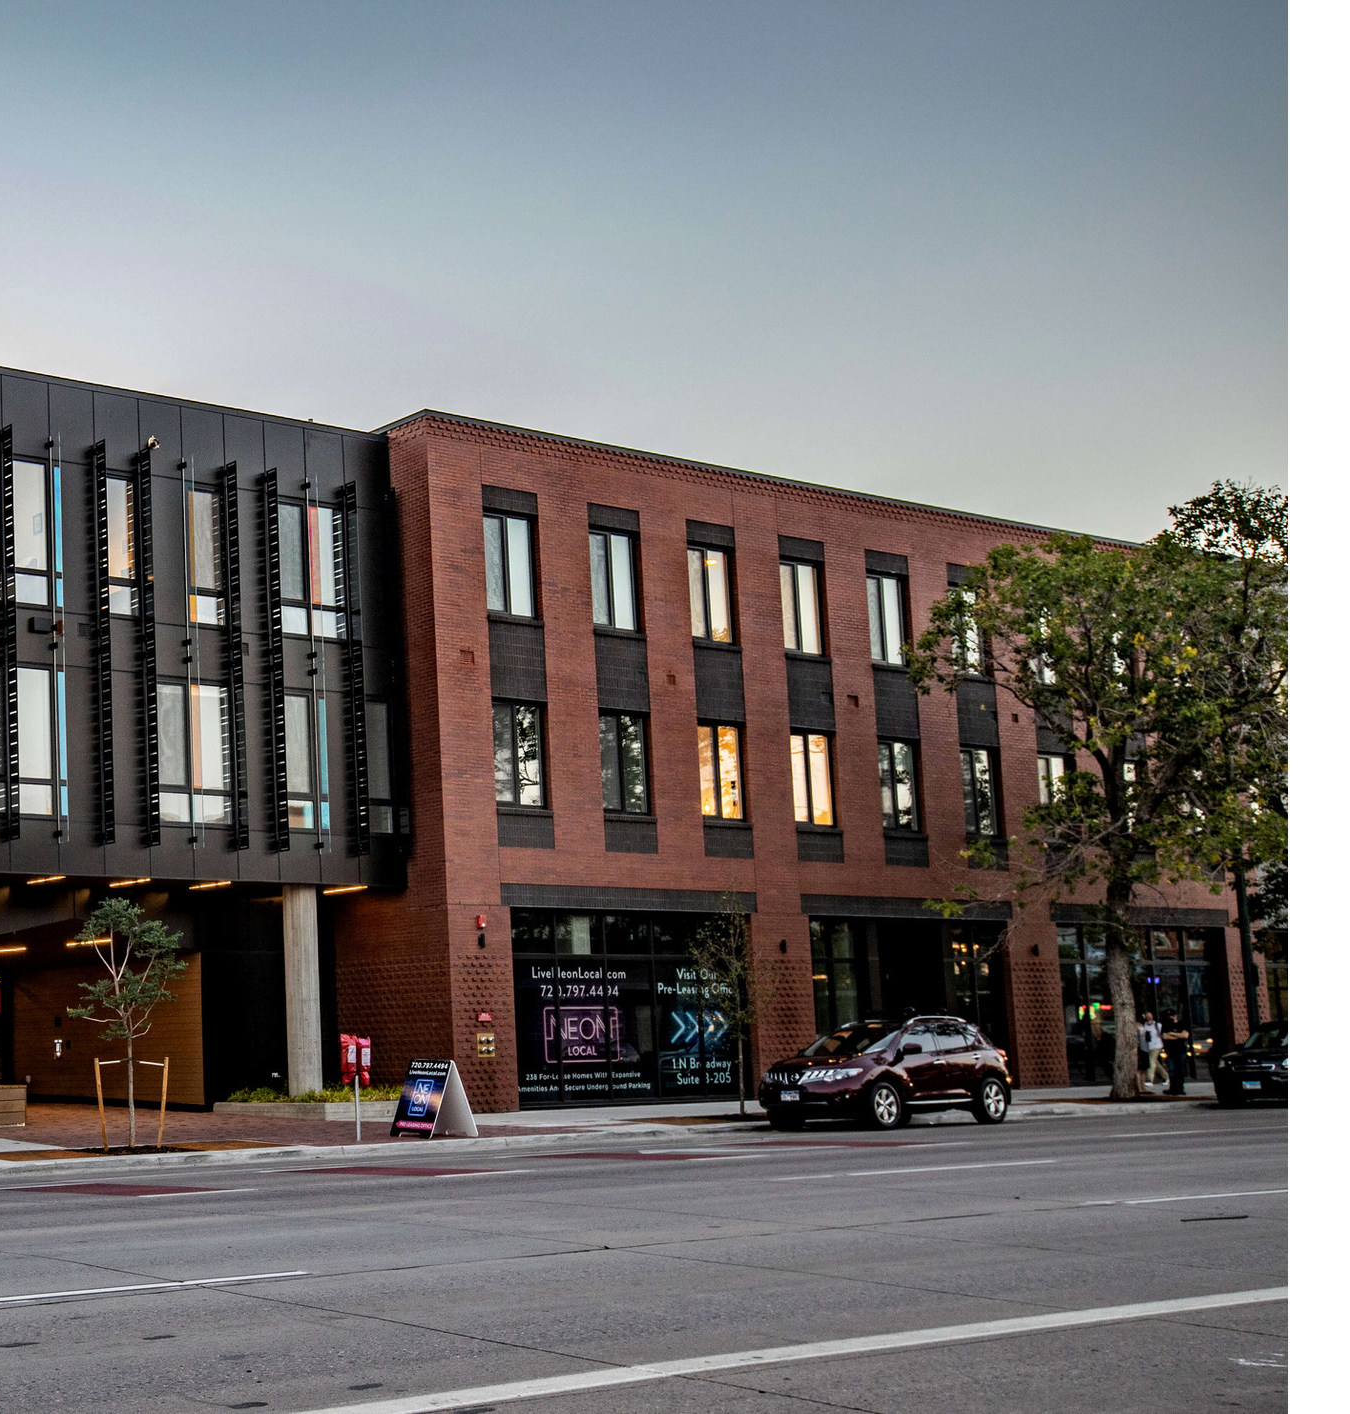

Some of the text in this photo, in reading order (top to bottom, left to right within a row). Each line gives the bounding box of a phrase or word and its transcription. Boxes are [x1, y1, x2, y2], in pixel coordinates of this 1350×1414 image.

[676, 967, 697, 980] Visit
[567, 1045, 598, 1056] LOCAL
[679, 1058, 687, 1069] N
[690, 1057, 731, 1072] Bradway
[526, 1073, 538, 1081] 238
[572, 1071, 593, 1079] Homes
[611, 1070, 641, 1079] Expansive
[677, 1073, 700, 1085] Suite
[628, 1082, 651, 1090] Parking
